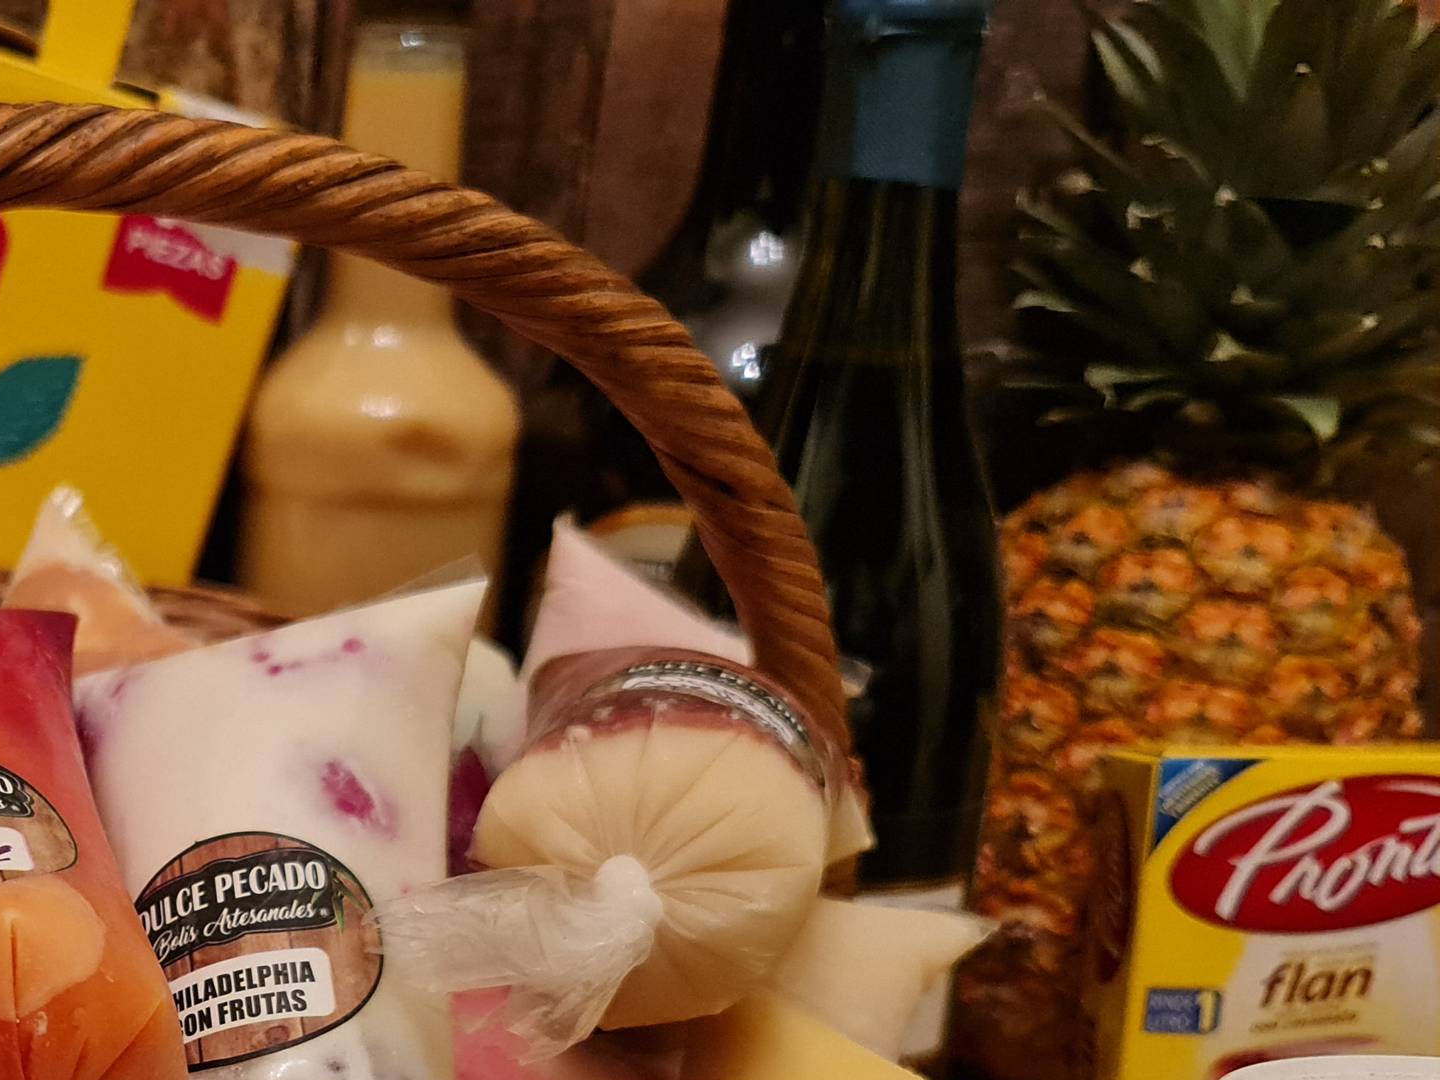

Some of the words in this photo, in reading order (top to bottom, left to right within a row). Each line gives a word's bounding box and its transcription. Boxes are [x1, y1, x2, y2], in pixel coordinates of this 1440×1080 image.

[127, 226, 227, 281] PIEZAS
[1192, 780, 1440, 921] Pront
[214, 861, 327, 904] PECADO
[153, 928, 198, 964] Bolis
[202, 899, 317, 937] Artesanales
[172, 960, 316, 1013] HILADELPHIA
[1260, 959, 1374, 1009] flan
[178, 1007, 213, 1038] ON
[218, 989, 308, 1025] FRUTAS
